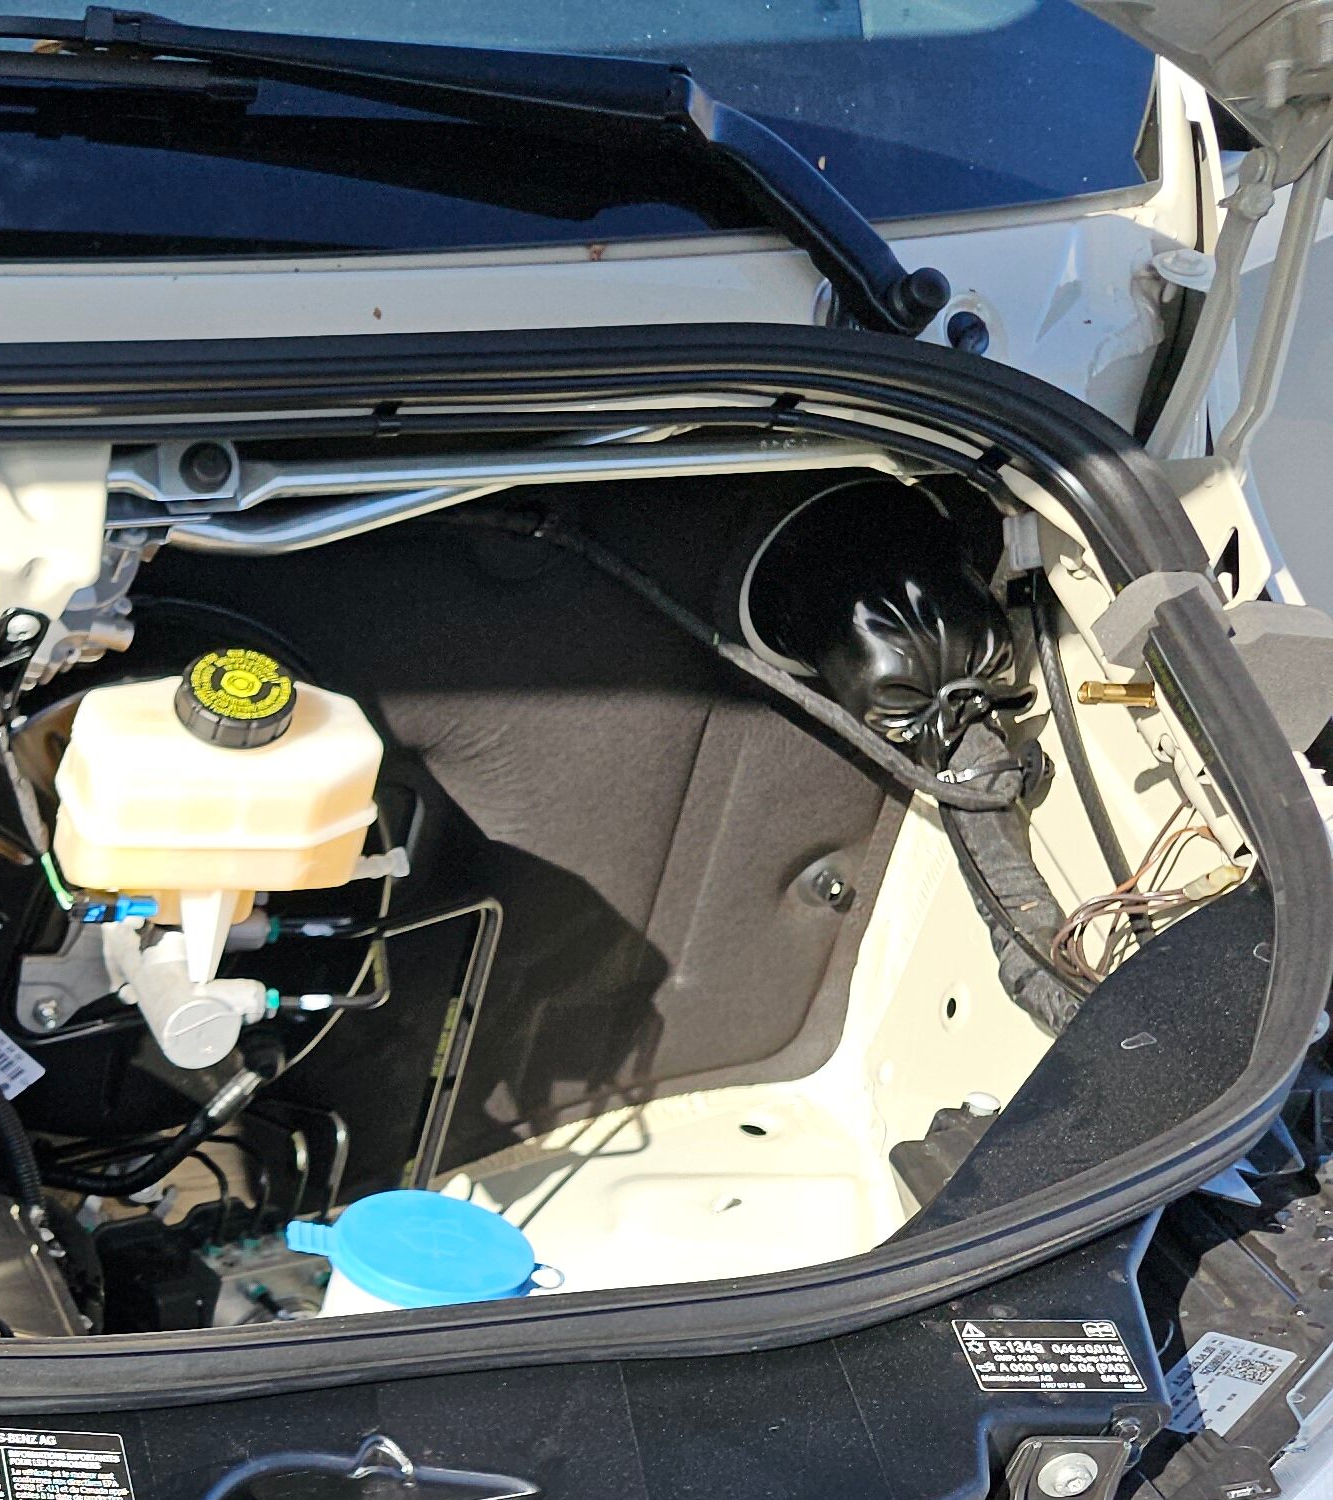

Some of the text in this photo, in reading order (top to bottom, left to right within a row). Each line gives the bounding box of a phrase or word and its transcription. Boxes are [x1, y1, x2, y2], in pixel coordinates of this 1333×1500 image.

[988, 1341, 1045, 1354] R-134a
[999, 1364, 1009, 1373] A
[1010, 1363, 1032, 1373] 000
[1035, 1363, 1058, 1373] 989
[1059, 1363, 1077, 1373] 06
[1077, 1363, 1095, 1373] 06
[39, 1435, 57, 1445] AG
